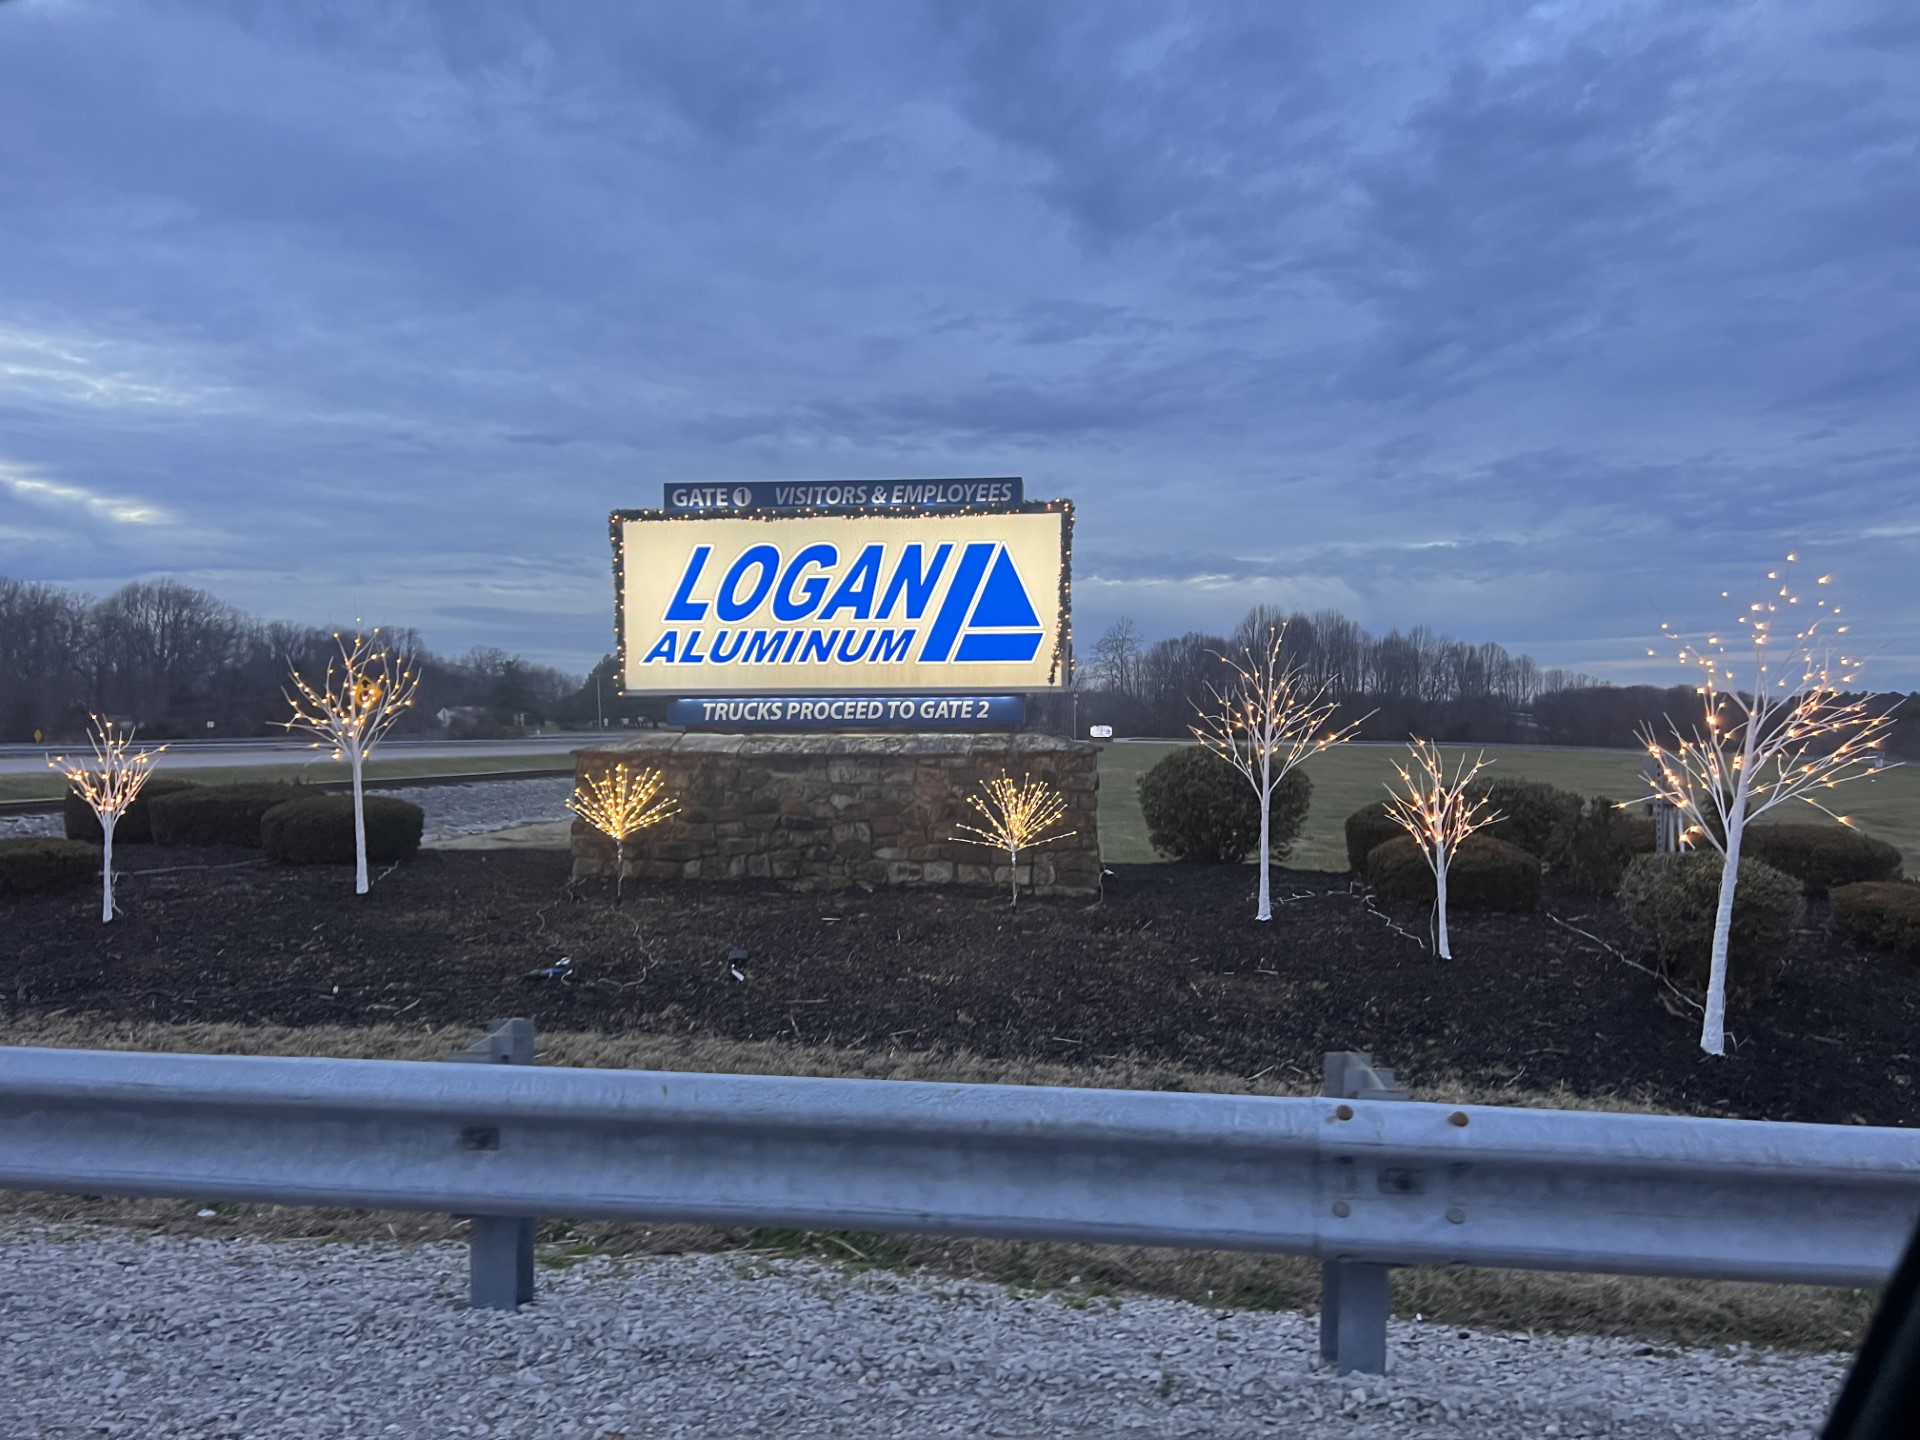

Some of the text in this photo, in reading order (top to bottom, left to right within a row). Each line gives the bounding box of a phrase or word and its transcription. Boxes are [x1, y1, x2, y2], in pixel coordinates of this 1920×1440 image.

[672, 483, 1012, 507] GATE 1 VISITORS & EMPLOYEES
[663, 543, 955, 622] LOGAN
[641, 628, 918, 663] ALUMINUM
[702, 700, 990, 721] TRUCKS PROCEED TO GATE 2
